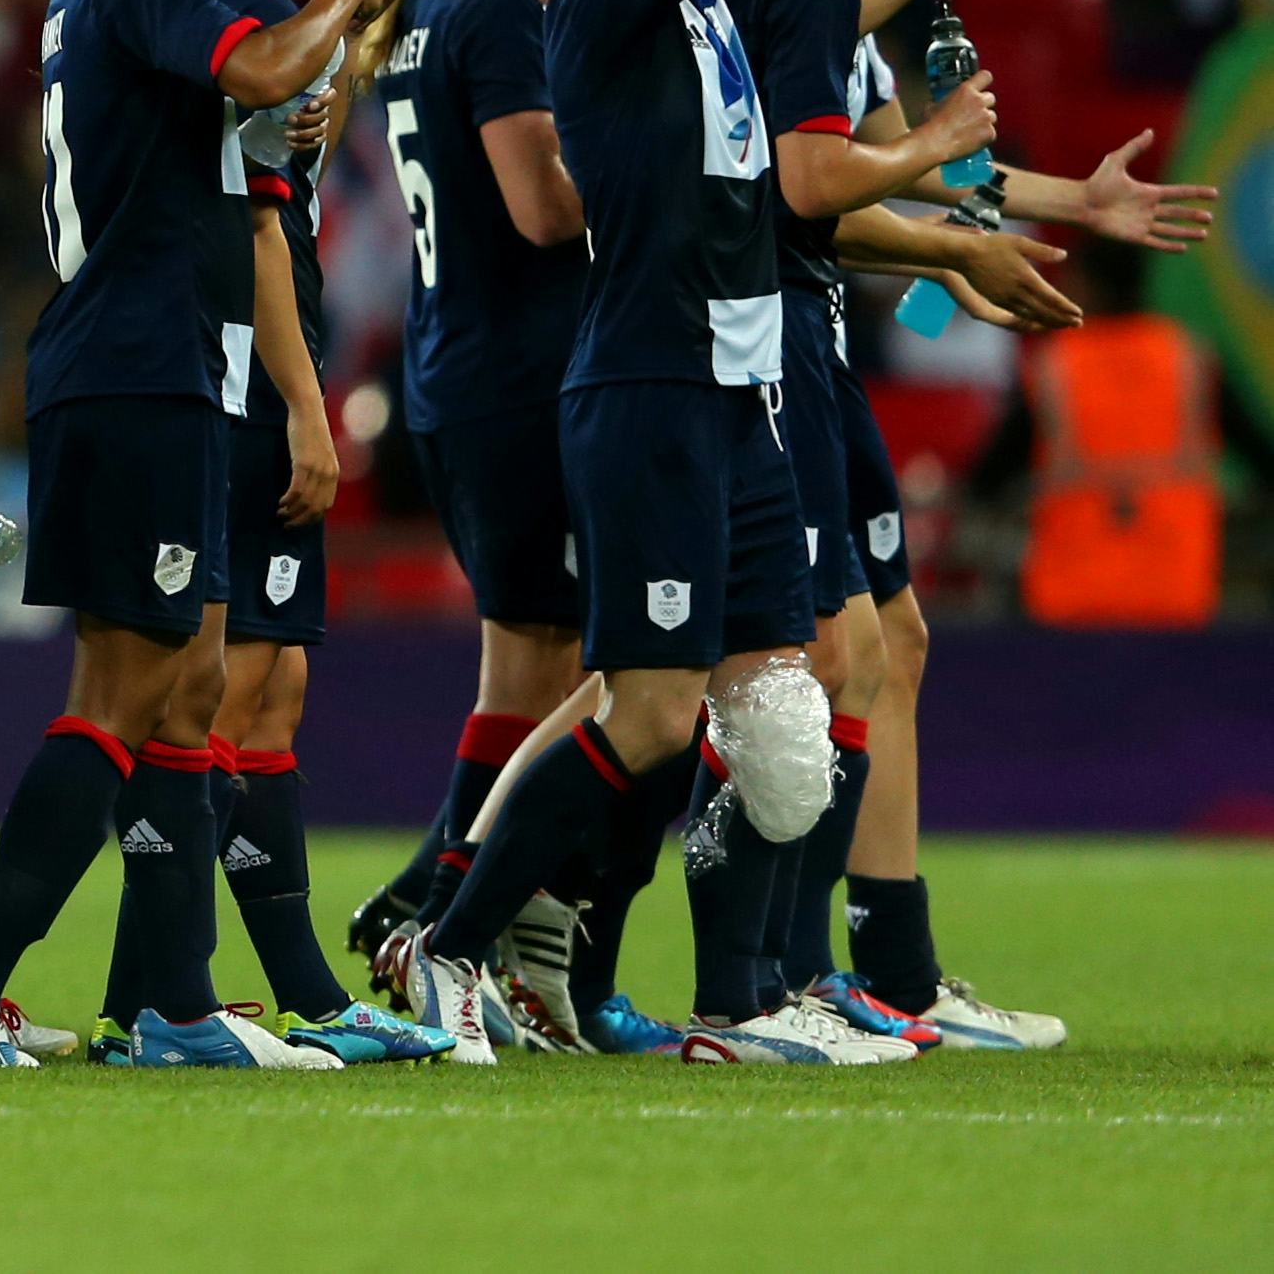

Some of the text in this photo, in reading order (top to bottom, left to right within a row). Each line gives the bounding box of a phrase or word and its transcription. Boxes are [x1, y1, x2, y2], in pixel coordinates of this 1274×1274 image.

[386, 99, 436, 289] 5
[121, 841, 174, 854] adidas
[223, 852, 272, 872] adidas
